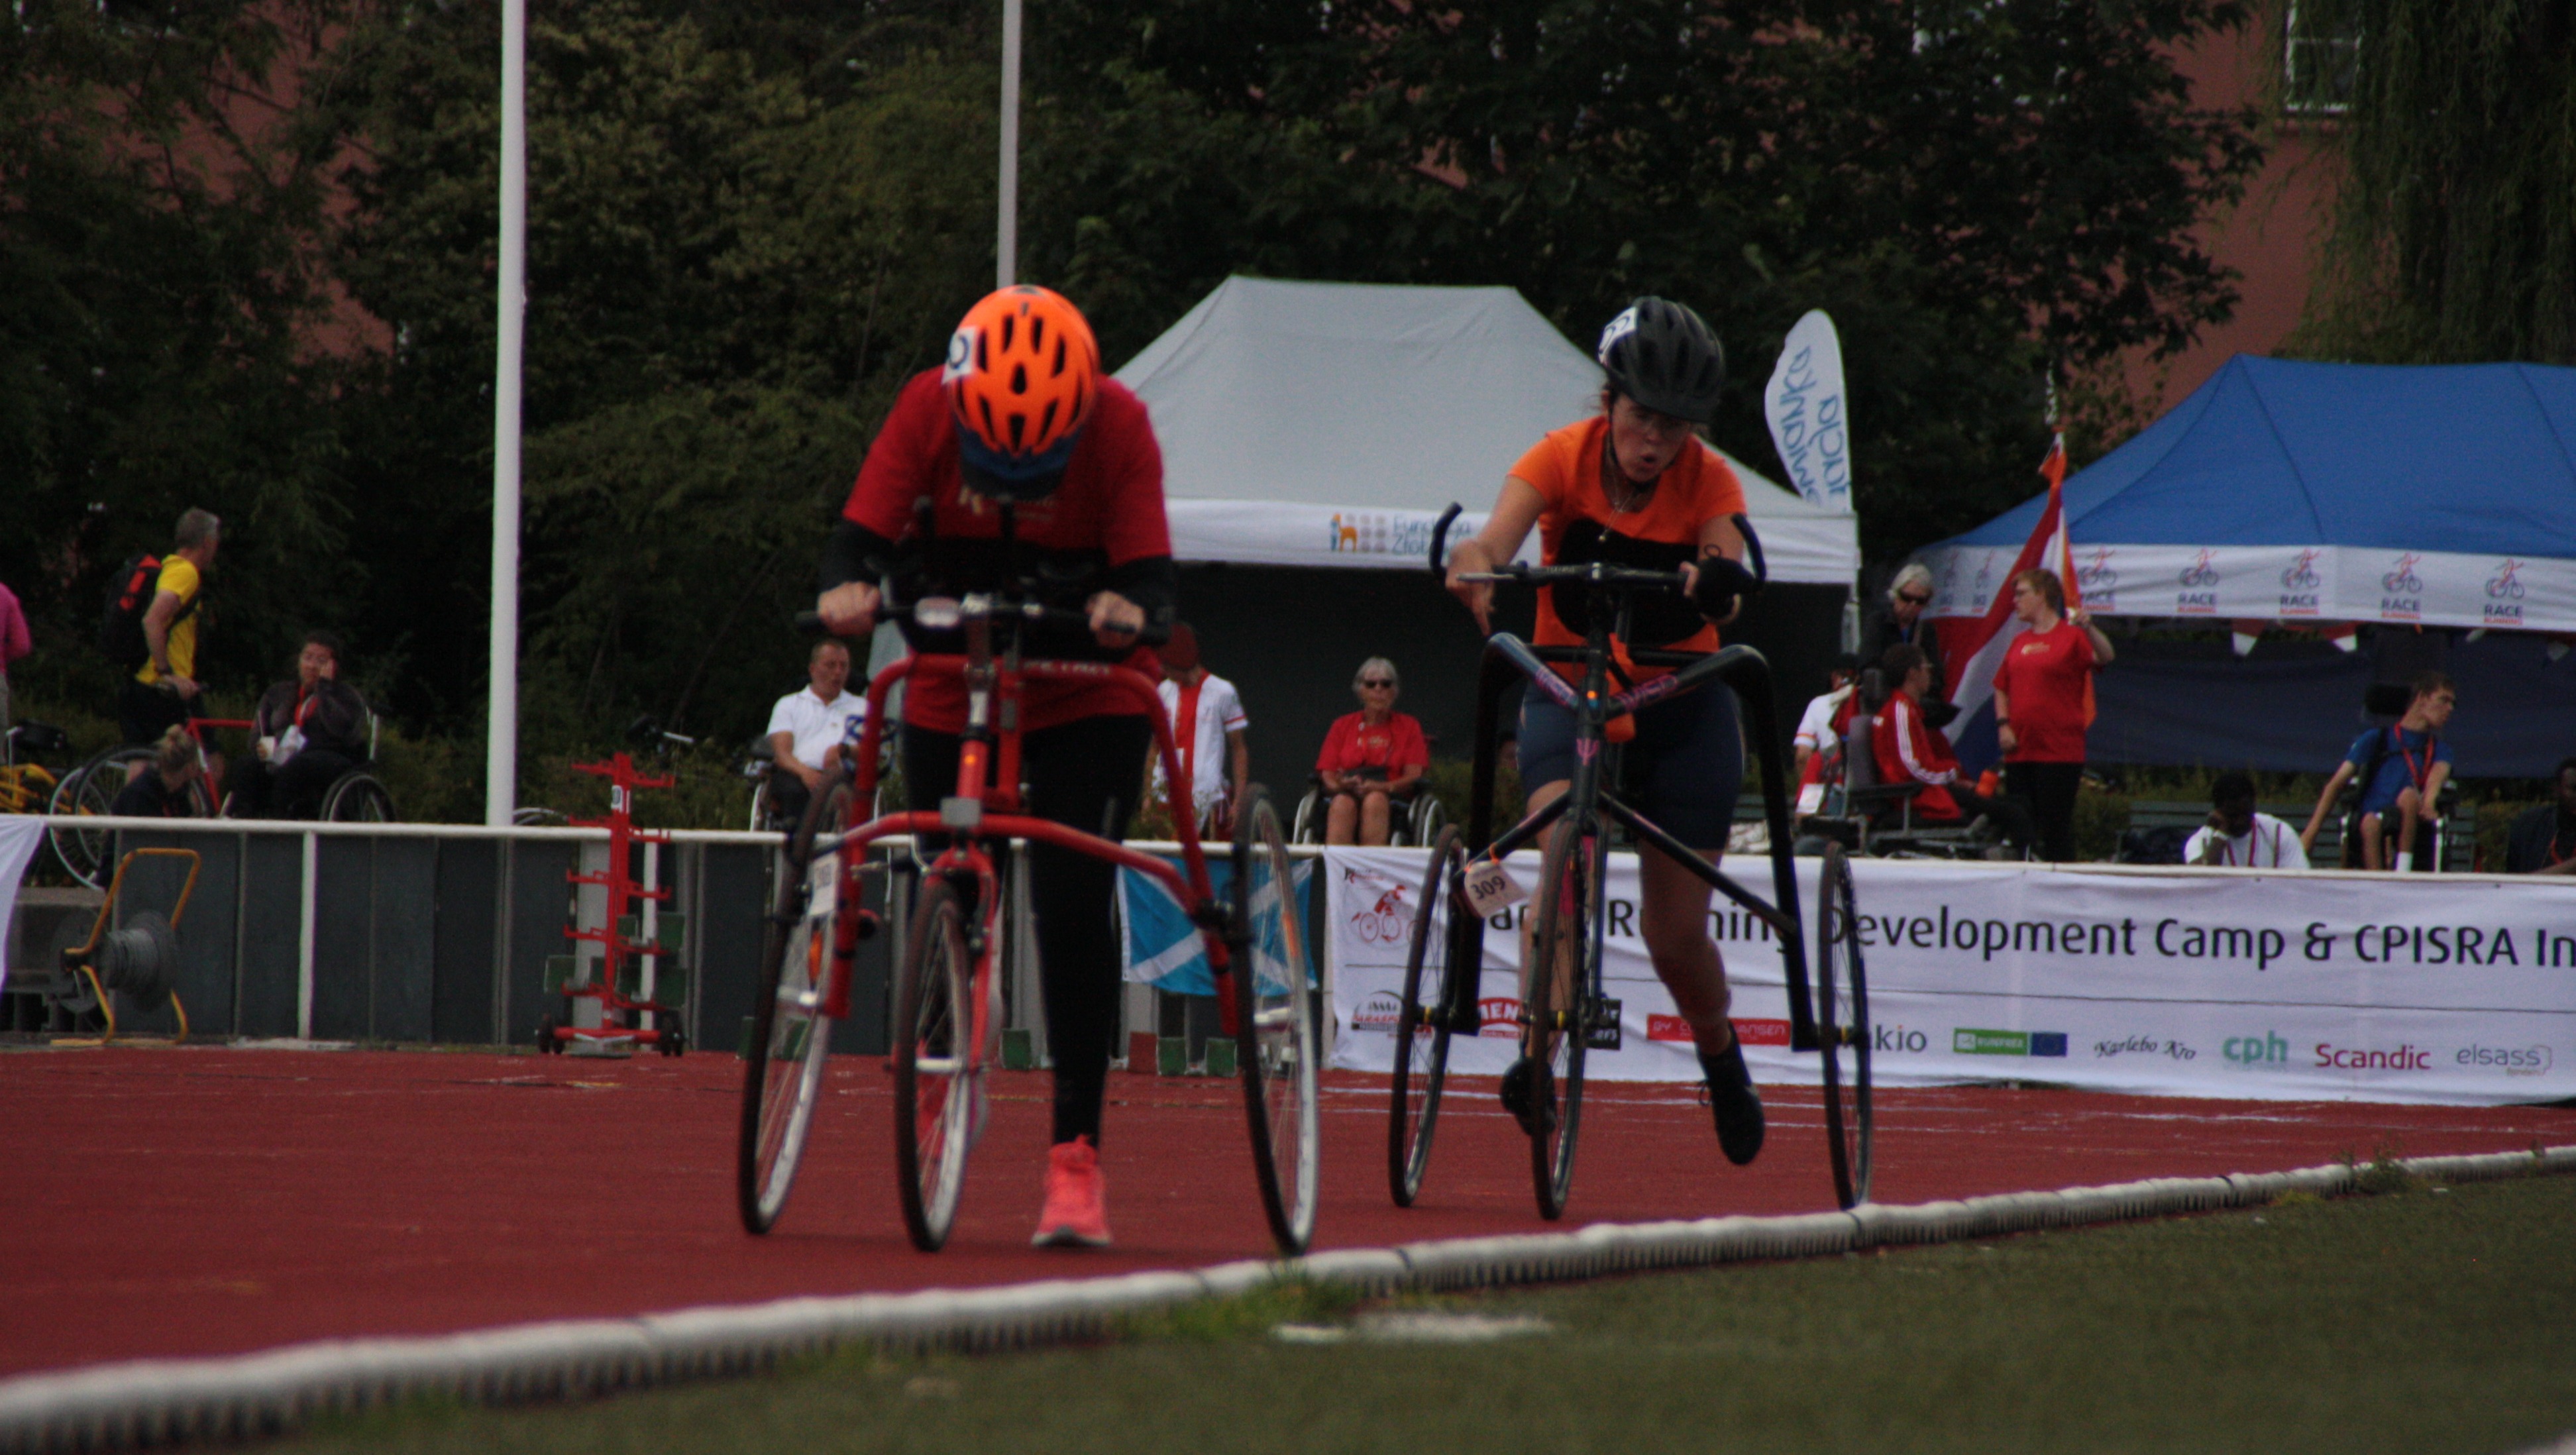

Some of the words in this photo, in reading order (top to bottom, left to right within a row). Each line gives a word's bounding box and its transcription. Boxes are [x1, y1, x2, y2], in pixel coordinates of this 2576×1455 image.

[2178, 592, 2216, 604] RACE
[2280, 595, 2318, 606] RACE
[2381, 598, 2419, 611] RACE
[2485, 604, 2523, 616] RACE
[1470, 875, 1505, 900] 309
[2155, 918, 2285, 971] Camp
[2304, 922, 2338, 961] &
[2355, 925, 2520, 965] CPISRA
[1874, 1024, 1927, 1053] kio
[2222, 1030, 2290, 1064] cph
[2315, 1043, 2432, 1070] Scandic
[2455, 1044, 2542, 1067] elsass
